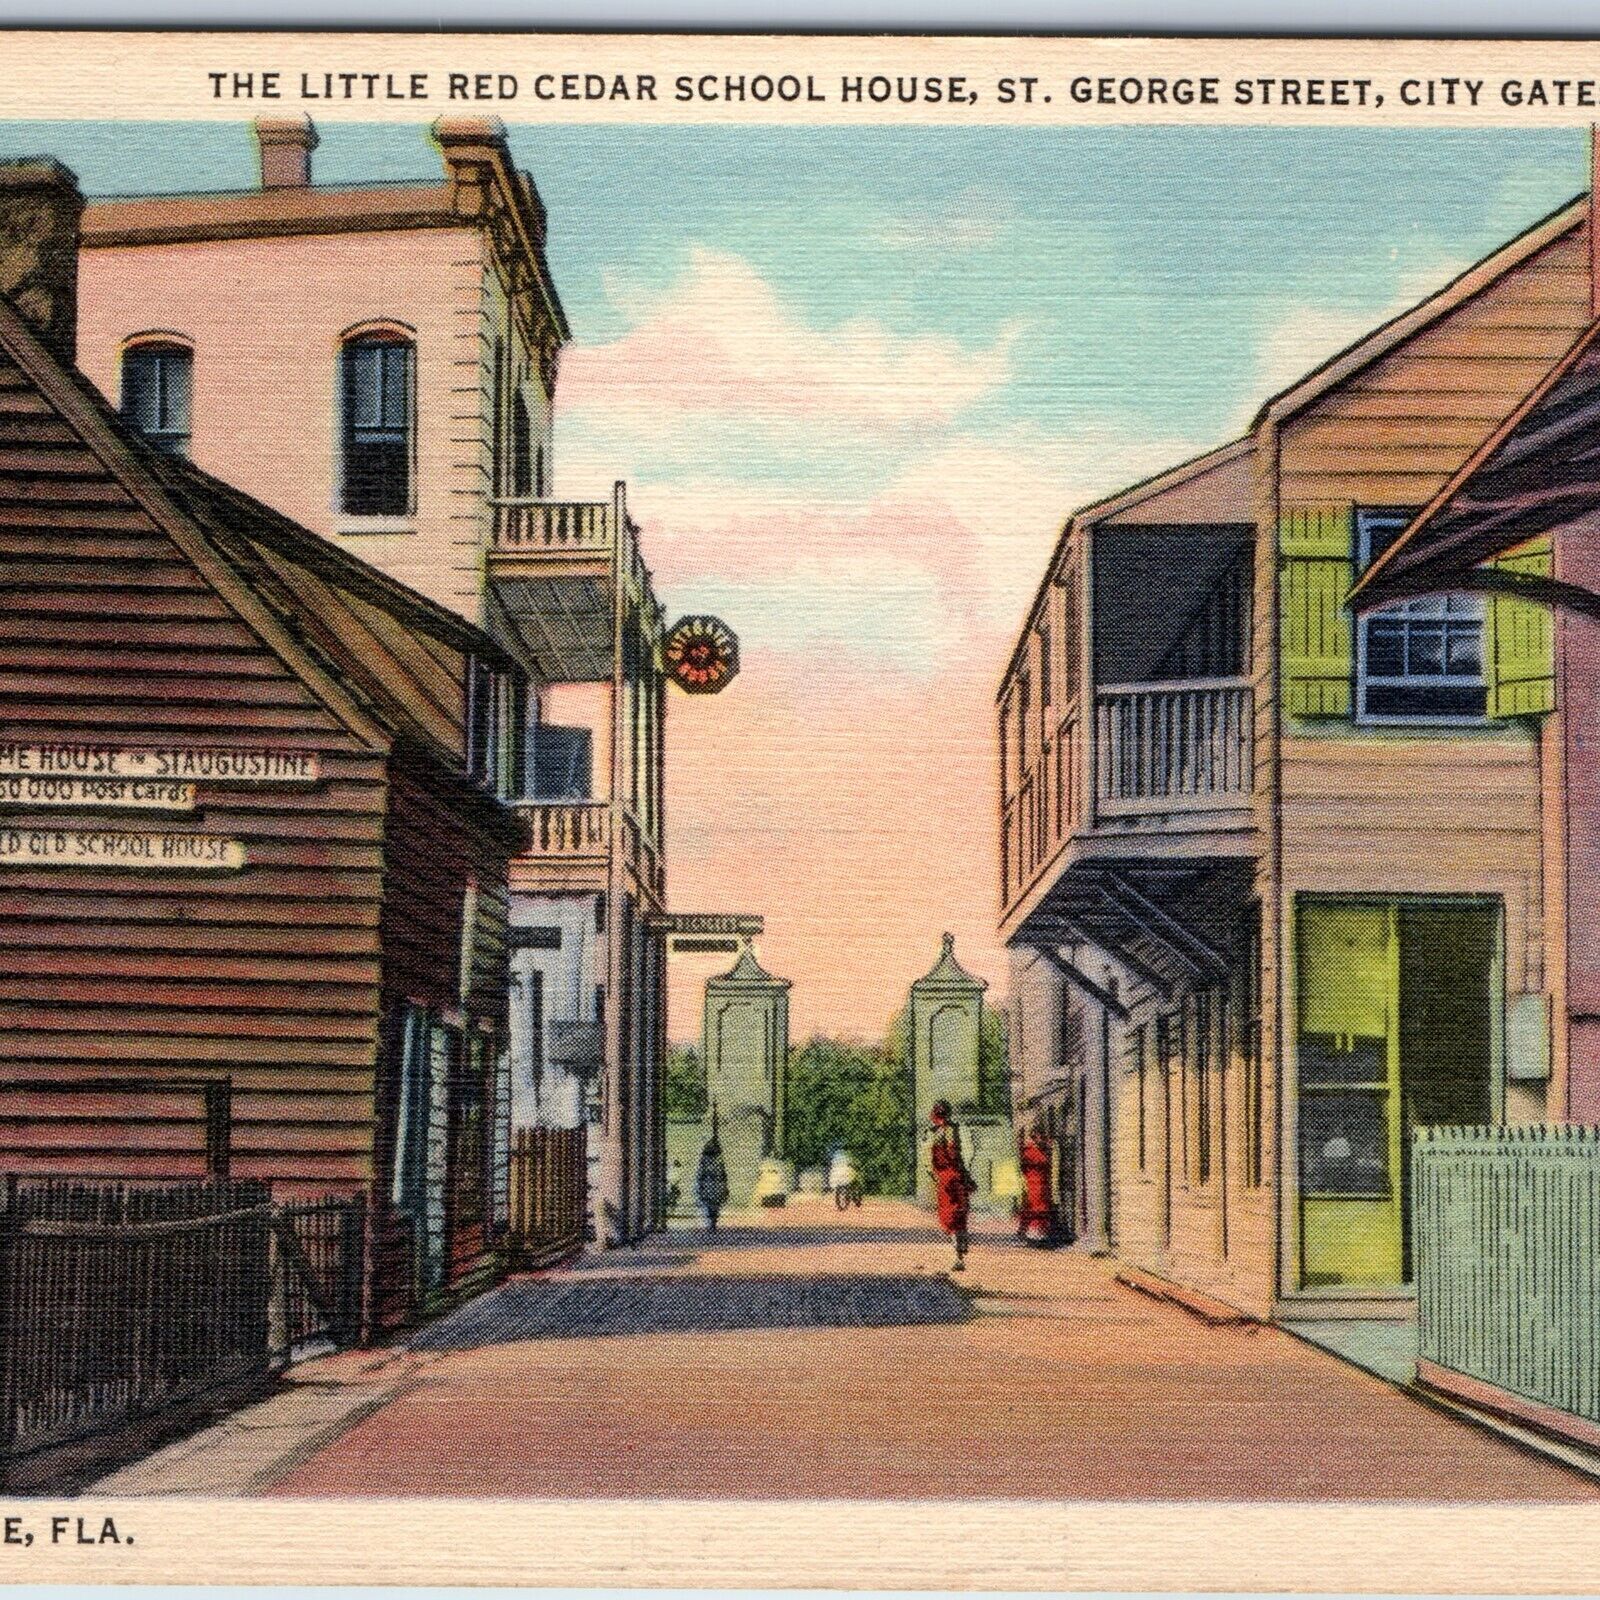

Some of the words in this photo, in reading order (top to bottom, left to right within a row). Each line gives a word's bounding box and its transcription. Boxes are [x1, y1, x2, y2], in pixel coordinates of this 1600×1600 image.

[208, 73, 281, 99] THE
[301, 73, 428, 99] LITTLE
[448, 74, 518, 100] RED
[534, 74, 657, 101] CEDAR
[675, 75, 826, 102] SCHOOL
[841, 76, 978, 106] HOUSE,
[997, 77, 1052, 104] ST.
[1070, 77, 1220, 105] GEORGE
[1234, 78, 1384, 109] STREET,
[1400, 78, 1484, 106] CITY
[1500, 79, 1600, 107] GATE
[40, 747, 118, 774] HOUSE
[82, 780, 125, 800] Post
[132, 781, 188, 803] Cards
[75, 835, 154, 858] SCHOOL
[162, 839, 228, 861] HOUSE
[51, 1516, 135, 1545] FLA.
